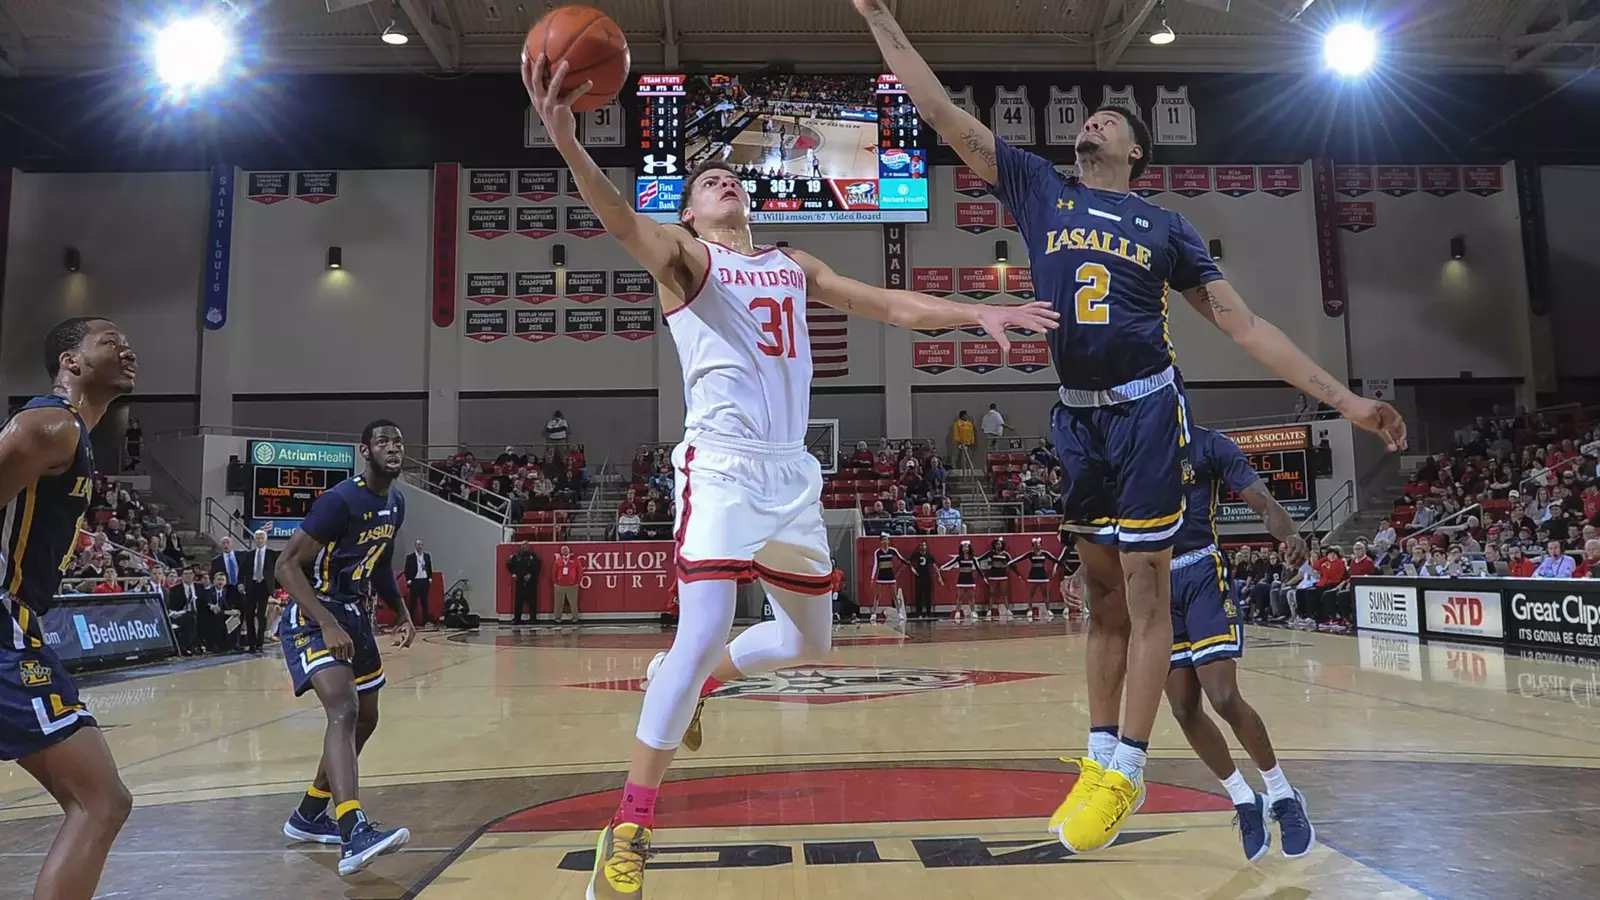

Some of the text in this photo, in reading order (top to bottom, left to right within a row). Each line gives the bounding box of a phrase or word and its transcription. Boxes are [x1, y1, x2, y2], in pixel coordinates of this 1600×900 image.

[595, 108, 611, 126] 31
[1003, 107, 1022, 124] 44
[1058, 107, 1074, 124] 10
[1167, 107, 1179, 124] 11
[770, 180, 795, 193] 36.7
[807, 180, 821, 193] 19
[659, 201, 675, 209] Bank
[763, 213, 813, 221] Williamson
[830, 212, 853, 220] Video
[856, 212, 881, 220] Board
[1135, 217, 1149, 228] RB
[214, 177, 227, 292] SAINT LOUIS
[889, 228, 901, 285] UMAS
[1045, 228, 1152, 271] LASALLE
[718, 267, 805, 291] DAVIDSON
[1075, 262, 1111, 325] 2
[749, 297, 797, 359] 31
[1253, 431, 1306, 443] ASSOCIATES
[279, 448, 352, 463] Atrium Health
[1272, 471, 1299, 480] LASALLE
[259, 488, 291, 496] DAVIDSON
[1290, 481, 1304, 496] 19
[264, 498, 282, 514] 35
[1223, 507, 1256, 516] DAVIDS
[356, 524, 395, 545] LASALL
[580, 575, 667, 589] OURT
[1441, 596, 1483, 626] ATD
[1511, 593, 1561, 622] Great
[1370, 611, 1408, 628] ENTERPRISES
[1519, 628, 1600, 647] IT'S GONNA BE GREAT
